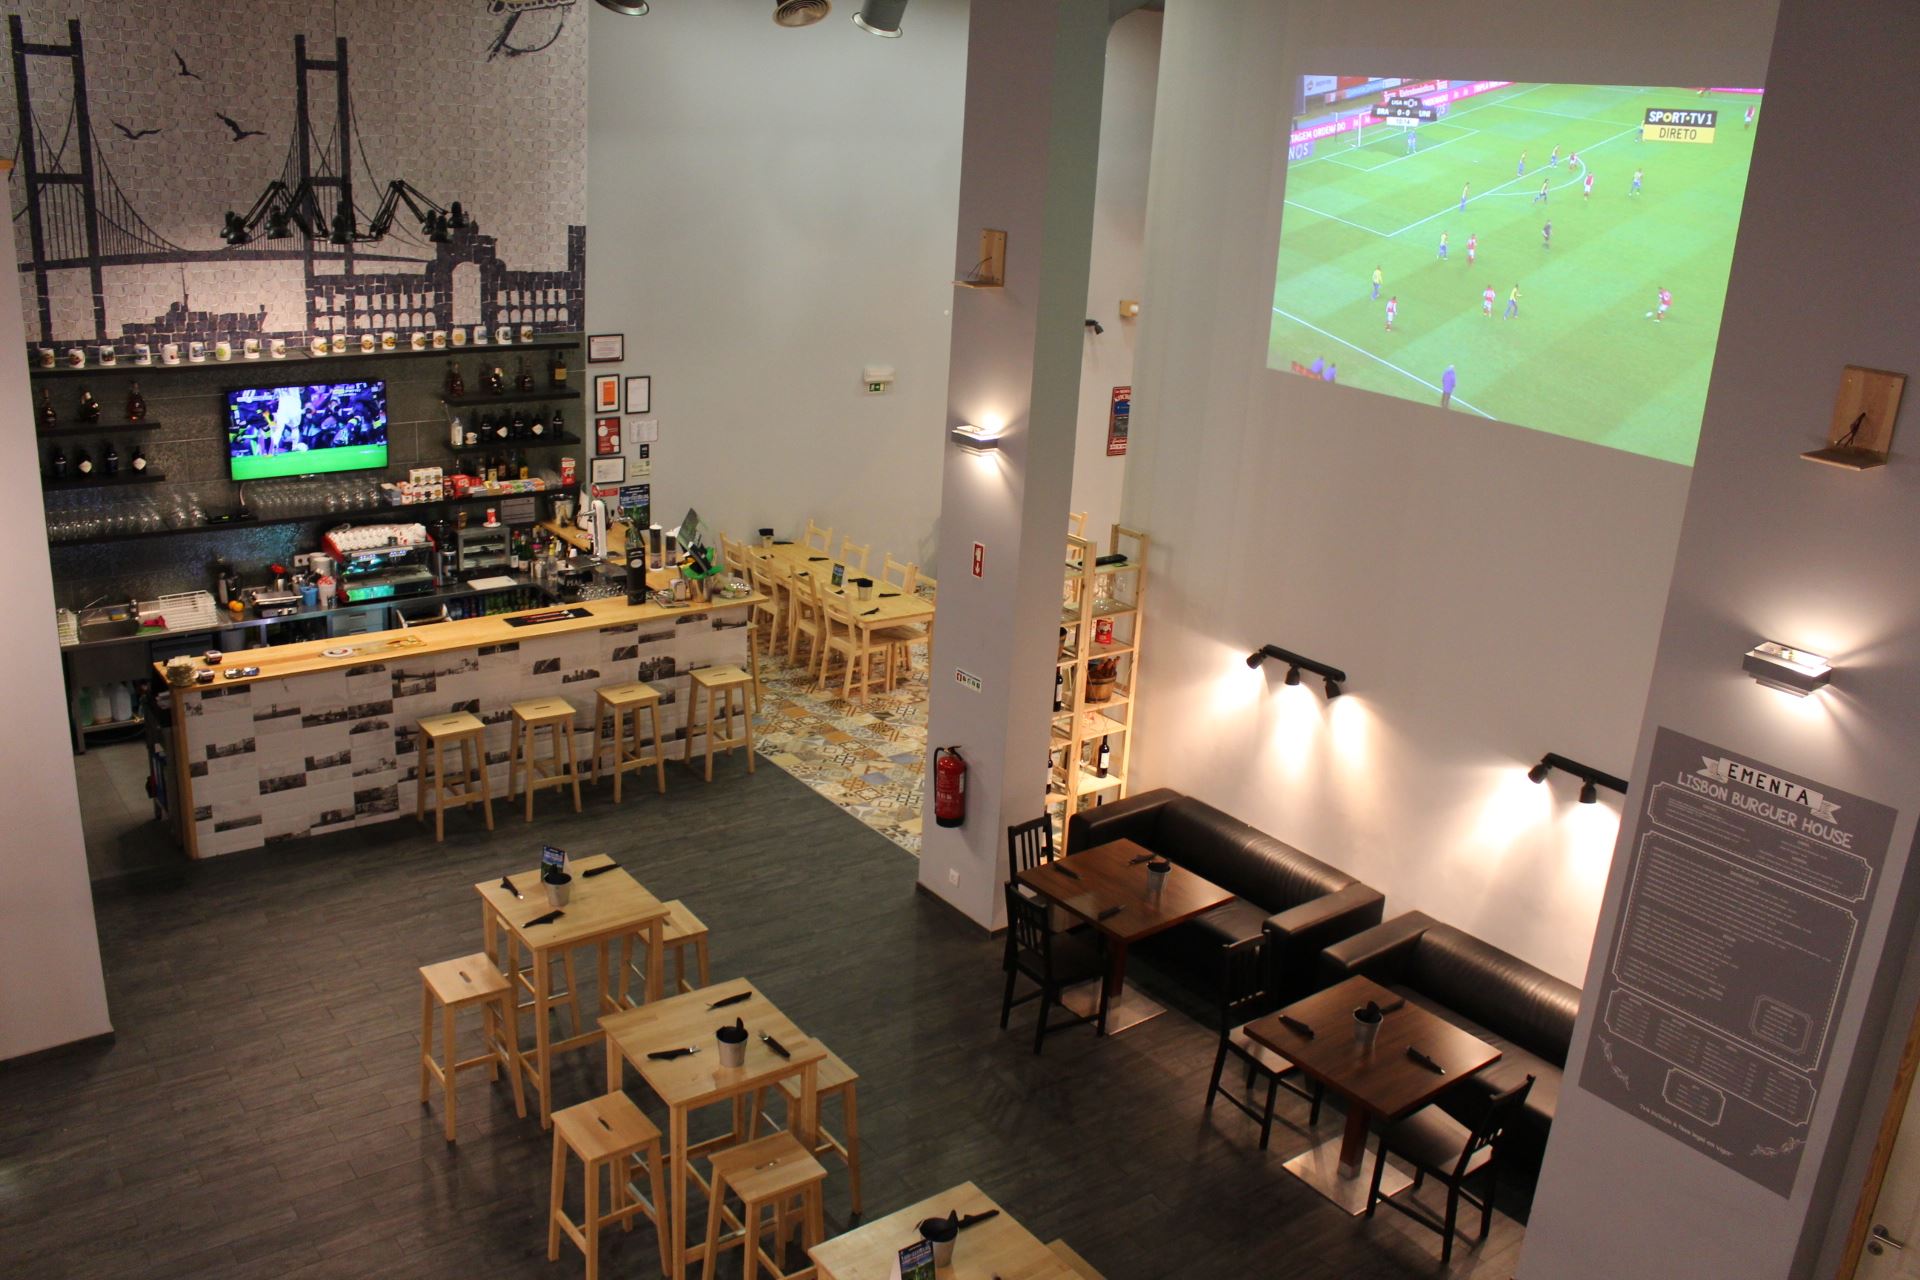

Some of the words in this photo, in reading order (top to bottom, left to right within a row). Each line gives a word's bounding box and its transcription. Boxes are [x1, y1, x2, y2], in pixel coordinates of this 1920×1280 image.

[1659, 127, 1697, 141] DIRETO
[1727, 763, 1809, 806] EMENTA
[1677, 771, 1729, 802] LISBON
[1731, 791, 1798, 829] BURGUER
[1801, 817, 1854, 849] HOUSE
